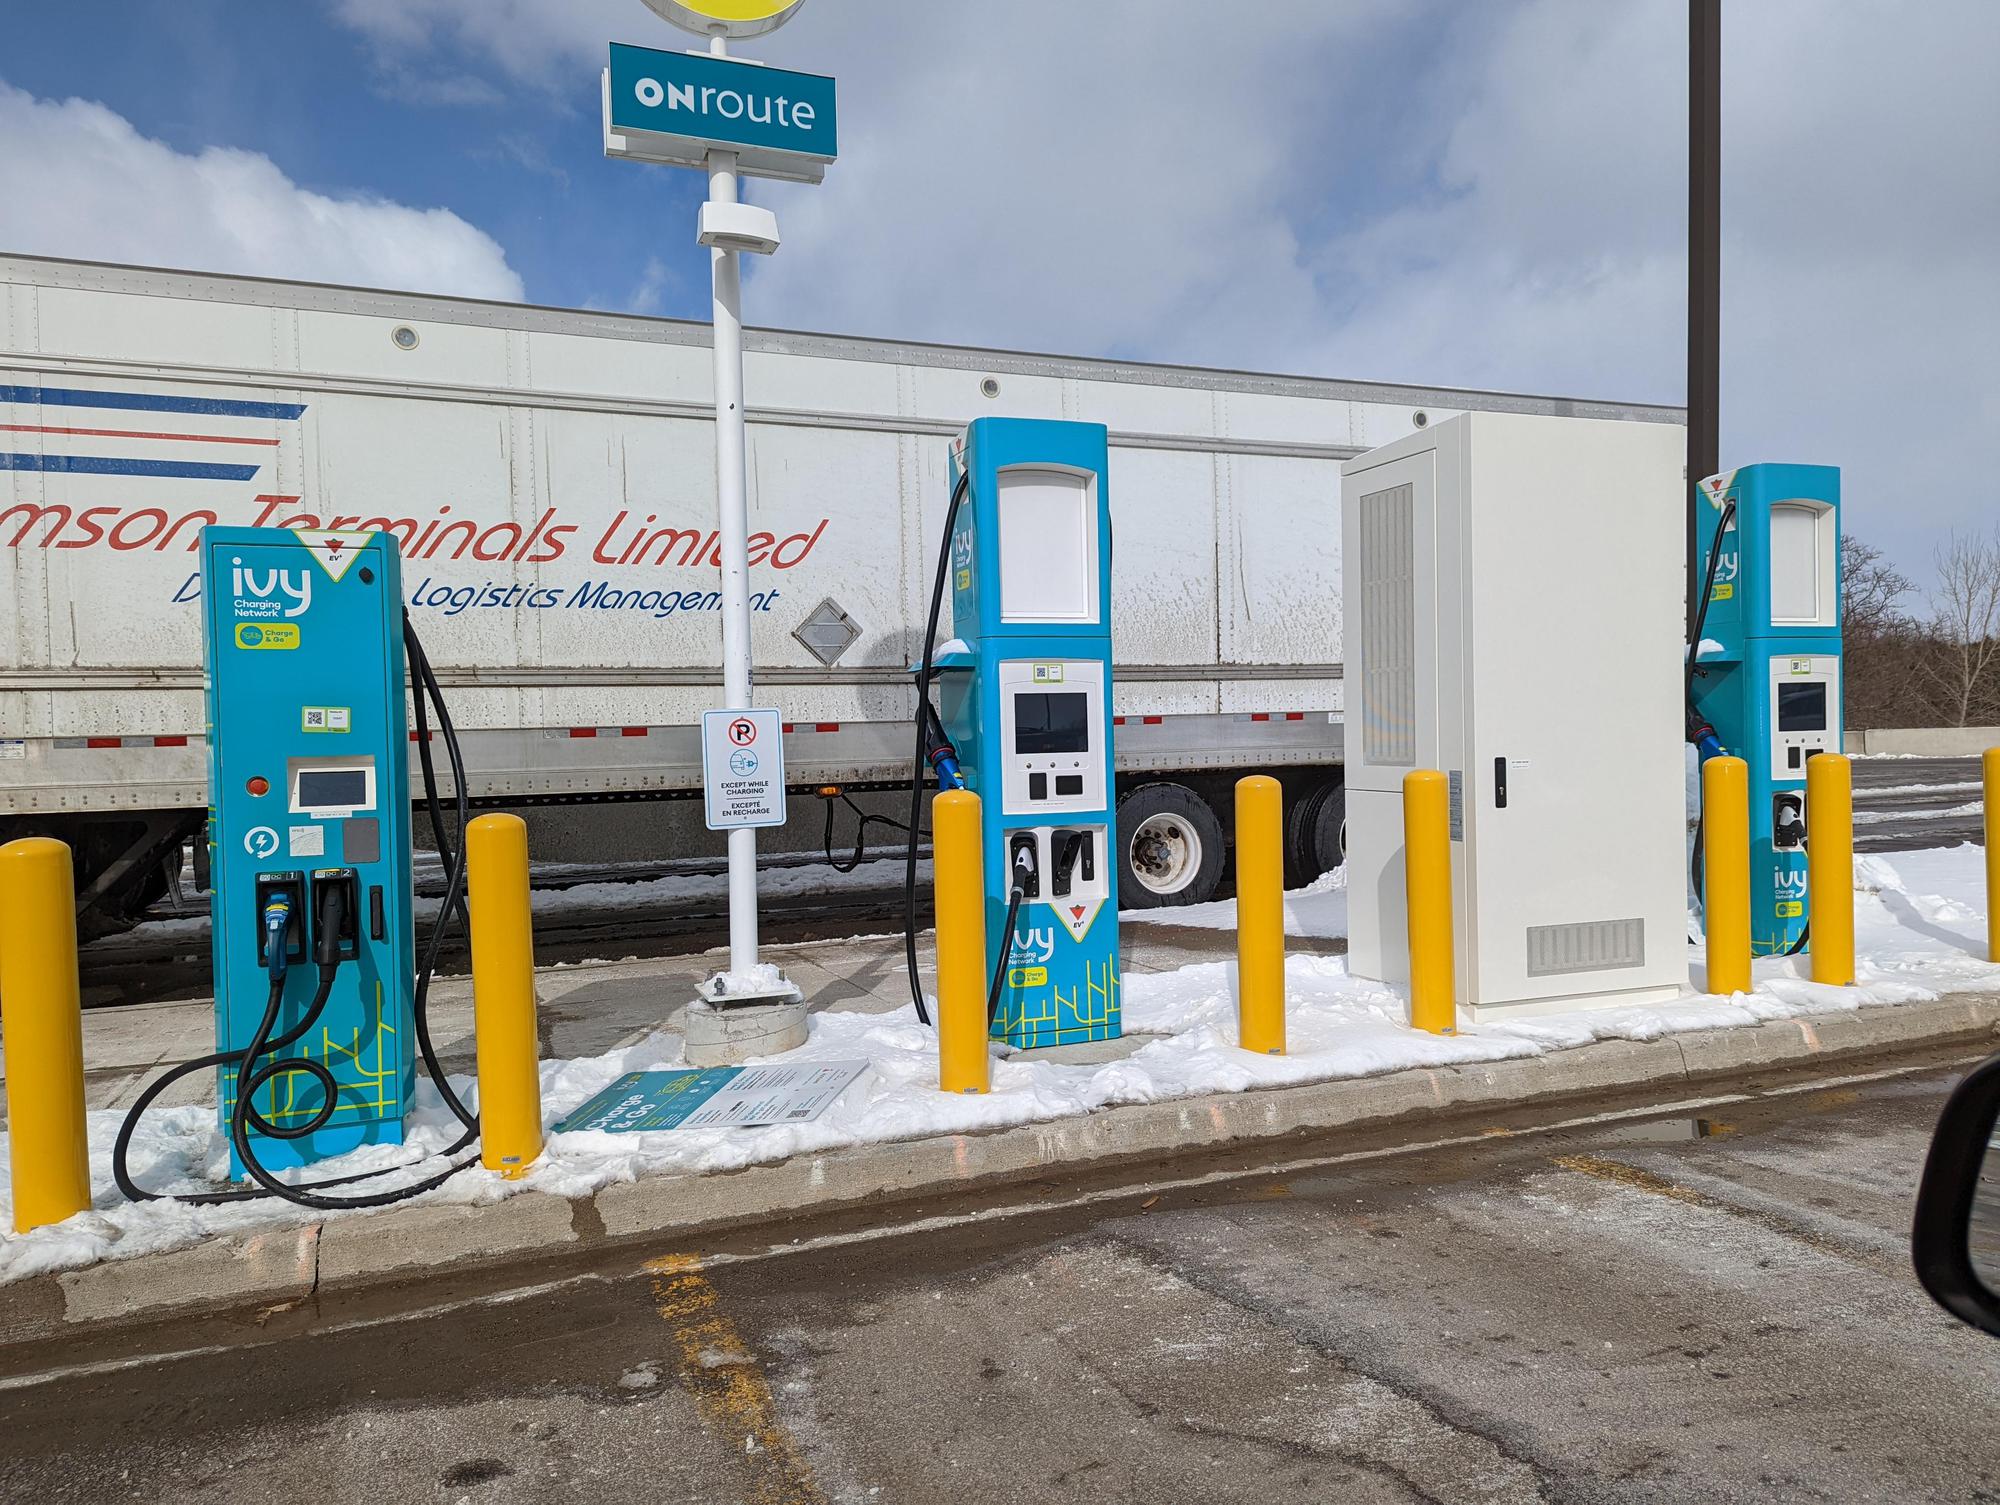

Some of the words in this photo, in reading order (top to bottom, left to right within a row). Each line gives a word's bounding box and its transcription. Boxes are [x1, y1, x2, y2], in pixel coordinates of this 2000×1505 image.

[634, 77, 816, 130] ONroute
[592, 510, 830, 570] Limied
[232, 556, 312, 618] ivy
[411, 577, 565, 616] Logistics
[565, 581, 780, 619] Managemnt
[233, 599, 281, 610] Charging
[234, 608, 279, 617] Network
[265, 629, 294, 638] Charge
[747, 780, 769, 788] WHILE
[731, 800, 761, 809] EXCEPTÉ
[733, 808, 771, 816] RECHARGE
[289, 871, 295, 879] 1
[343, 869, 350, 877] 2
[1774, 865, 1807, 898] ivy
[1010, 927, 1054, 963] vy
